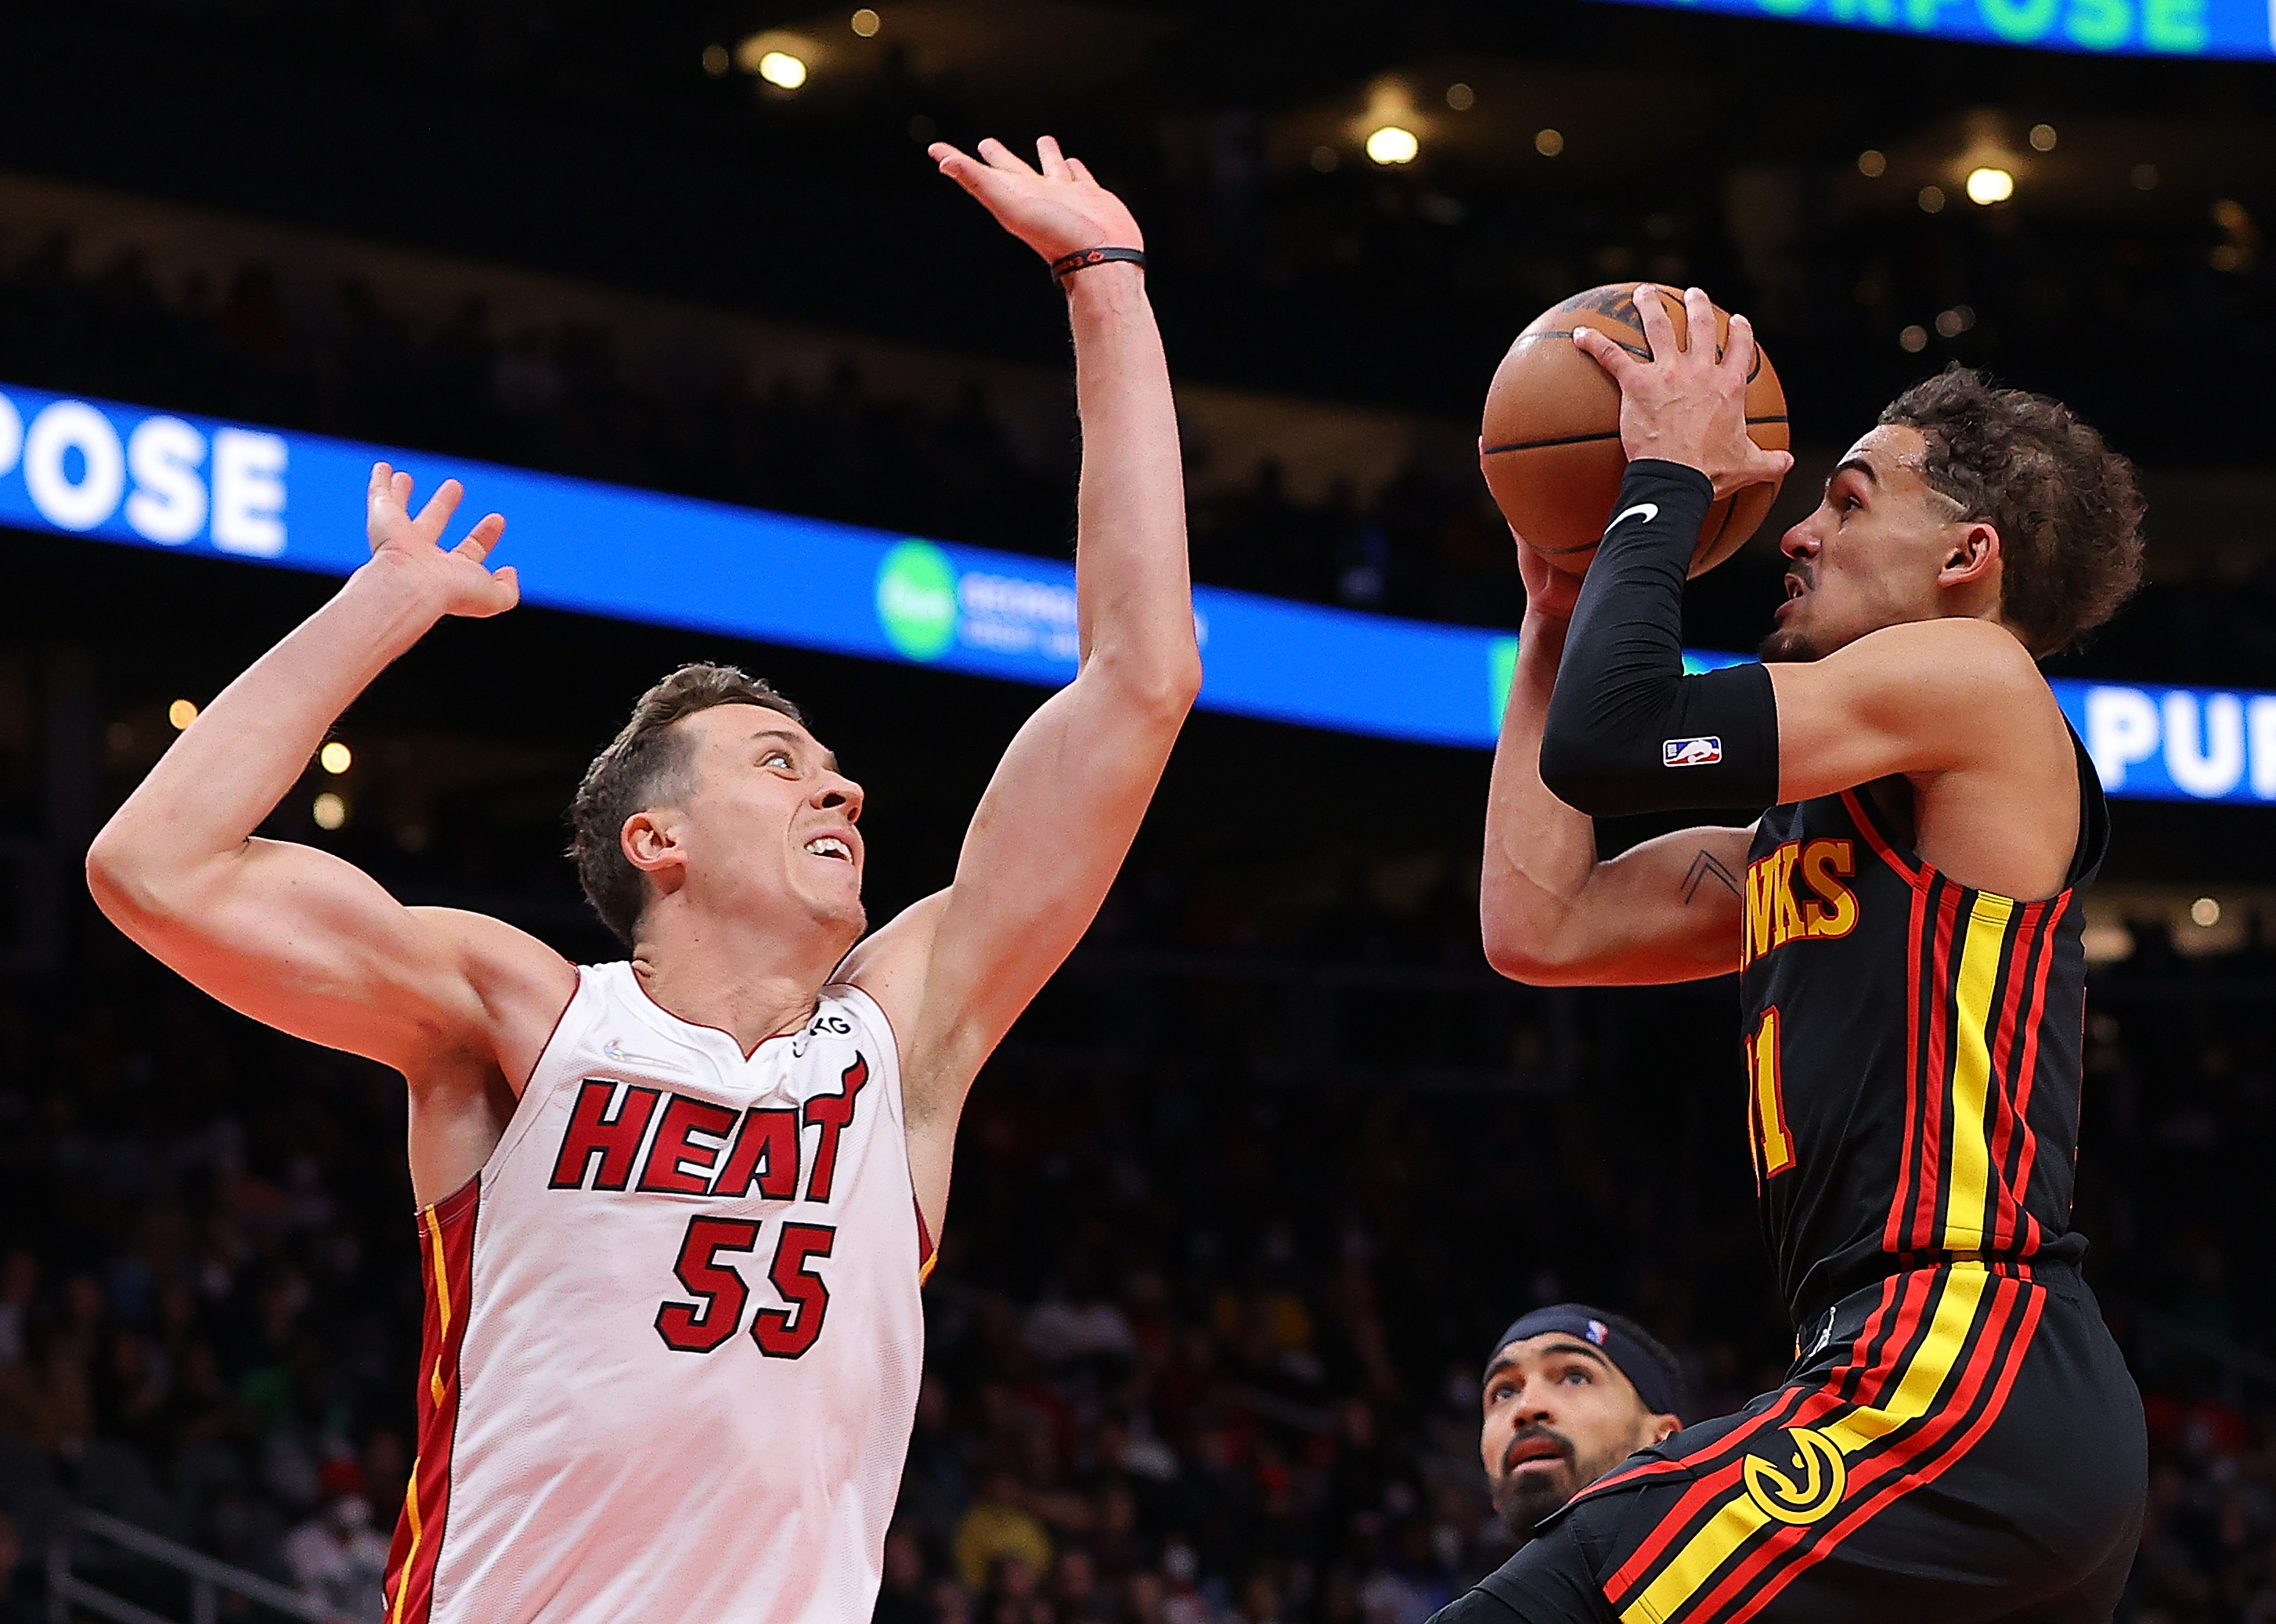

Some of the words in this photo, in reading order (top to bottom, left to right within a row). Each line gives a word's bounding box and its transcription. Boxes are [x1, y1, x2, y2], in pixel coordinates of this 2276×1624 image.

[0, 396, 289, 559] OSE
[1740, 838, 1859, 974] WKS
[548, 1050, 867, 1204] HEAT
[1745, 1005, 1796, 1182] 1
[654, 1214, 836, 1360] 55
